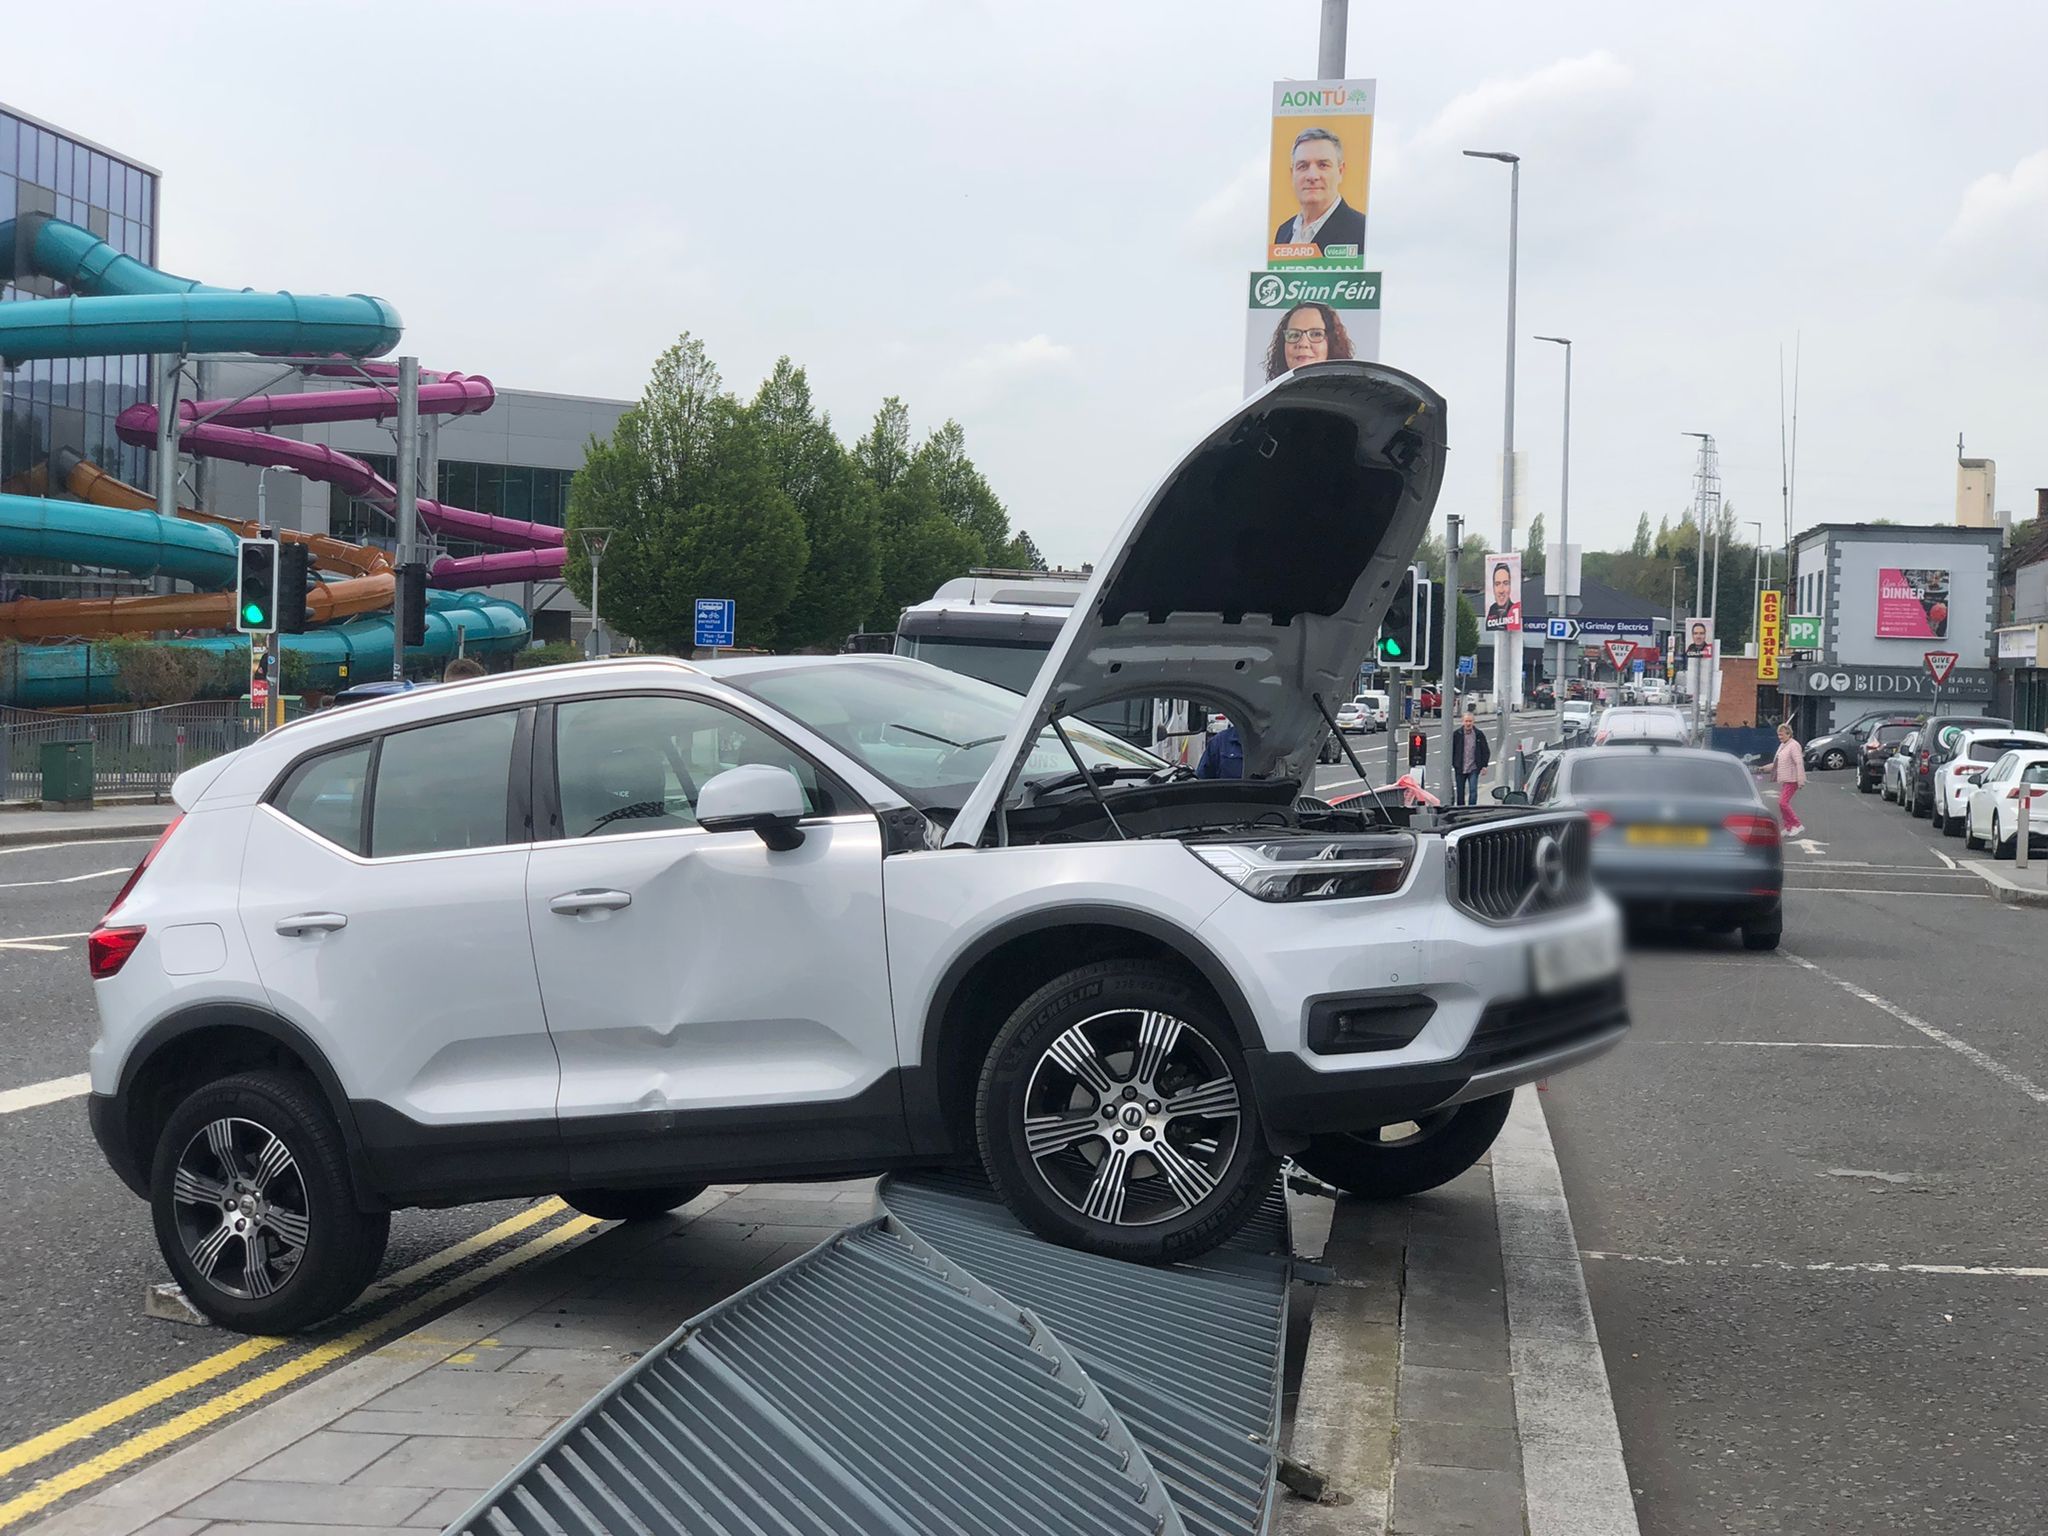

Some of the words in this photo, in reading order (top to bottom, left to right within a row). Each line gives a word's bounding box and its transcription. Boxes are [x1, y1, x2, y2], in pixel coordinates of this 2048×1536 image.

[1280, 86, 1346, 106] AONTÚ
[1273, 247, 1315, 256] GERARD
[1285, 281, 1330, 299] Sinn
[1331, 280, 1376, 300] Féin
[1882, 587, 1925, 600] DINNER
[1487, 616, 1514, 628] COLLINS
[1512, 608, 1519, 625] 1
[1555, 623, 1564, 635] P
[1585, 622, 1615, 632] Grimley
[1617, 622, 1649, 631] Electrics
[1019, 980, 1105, 1045] MICHELIN
